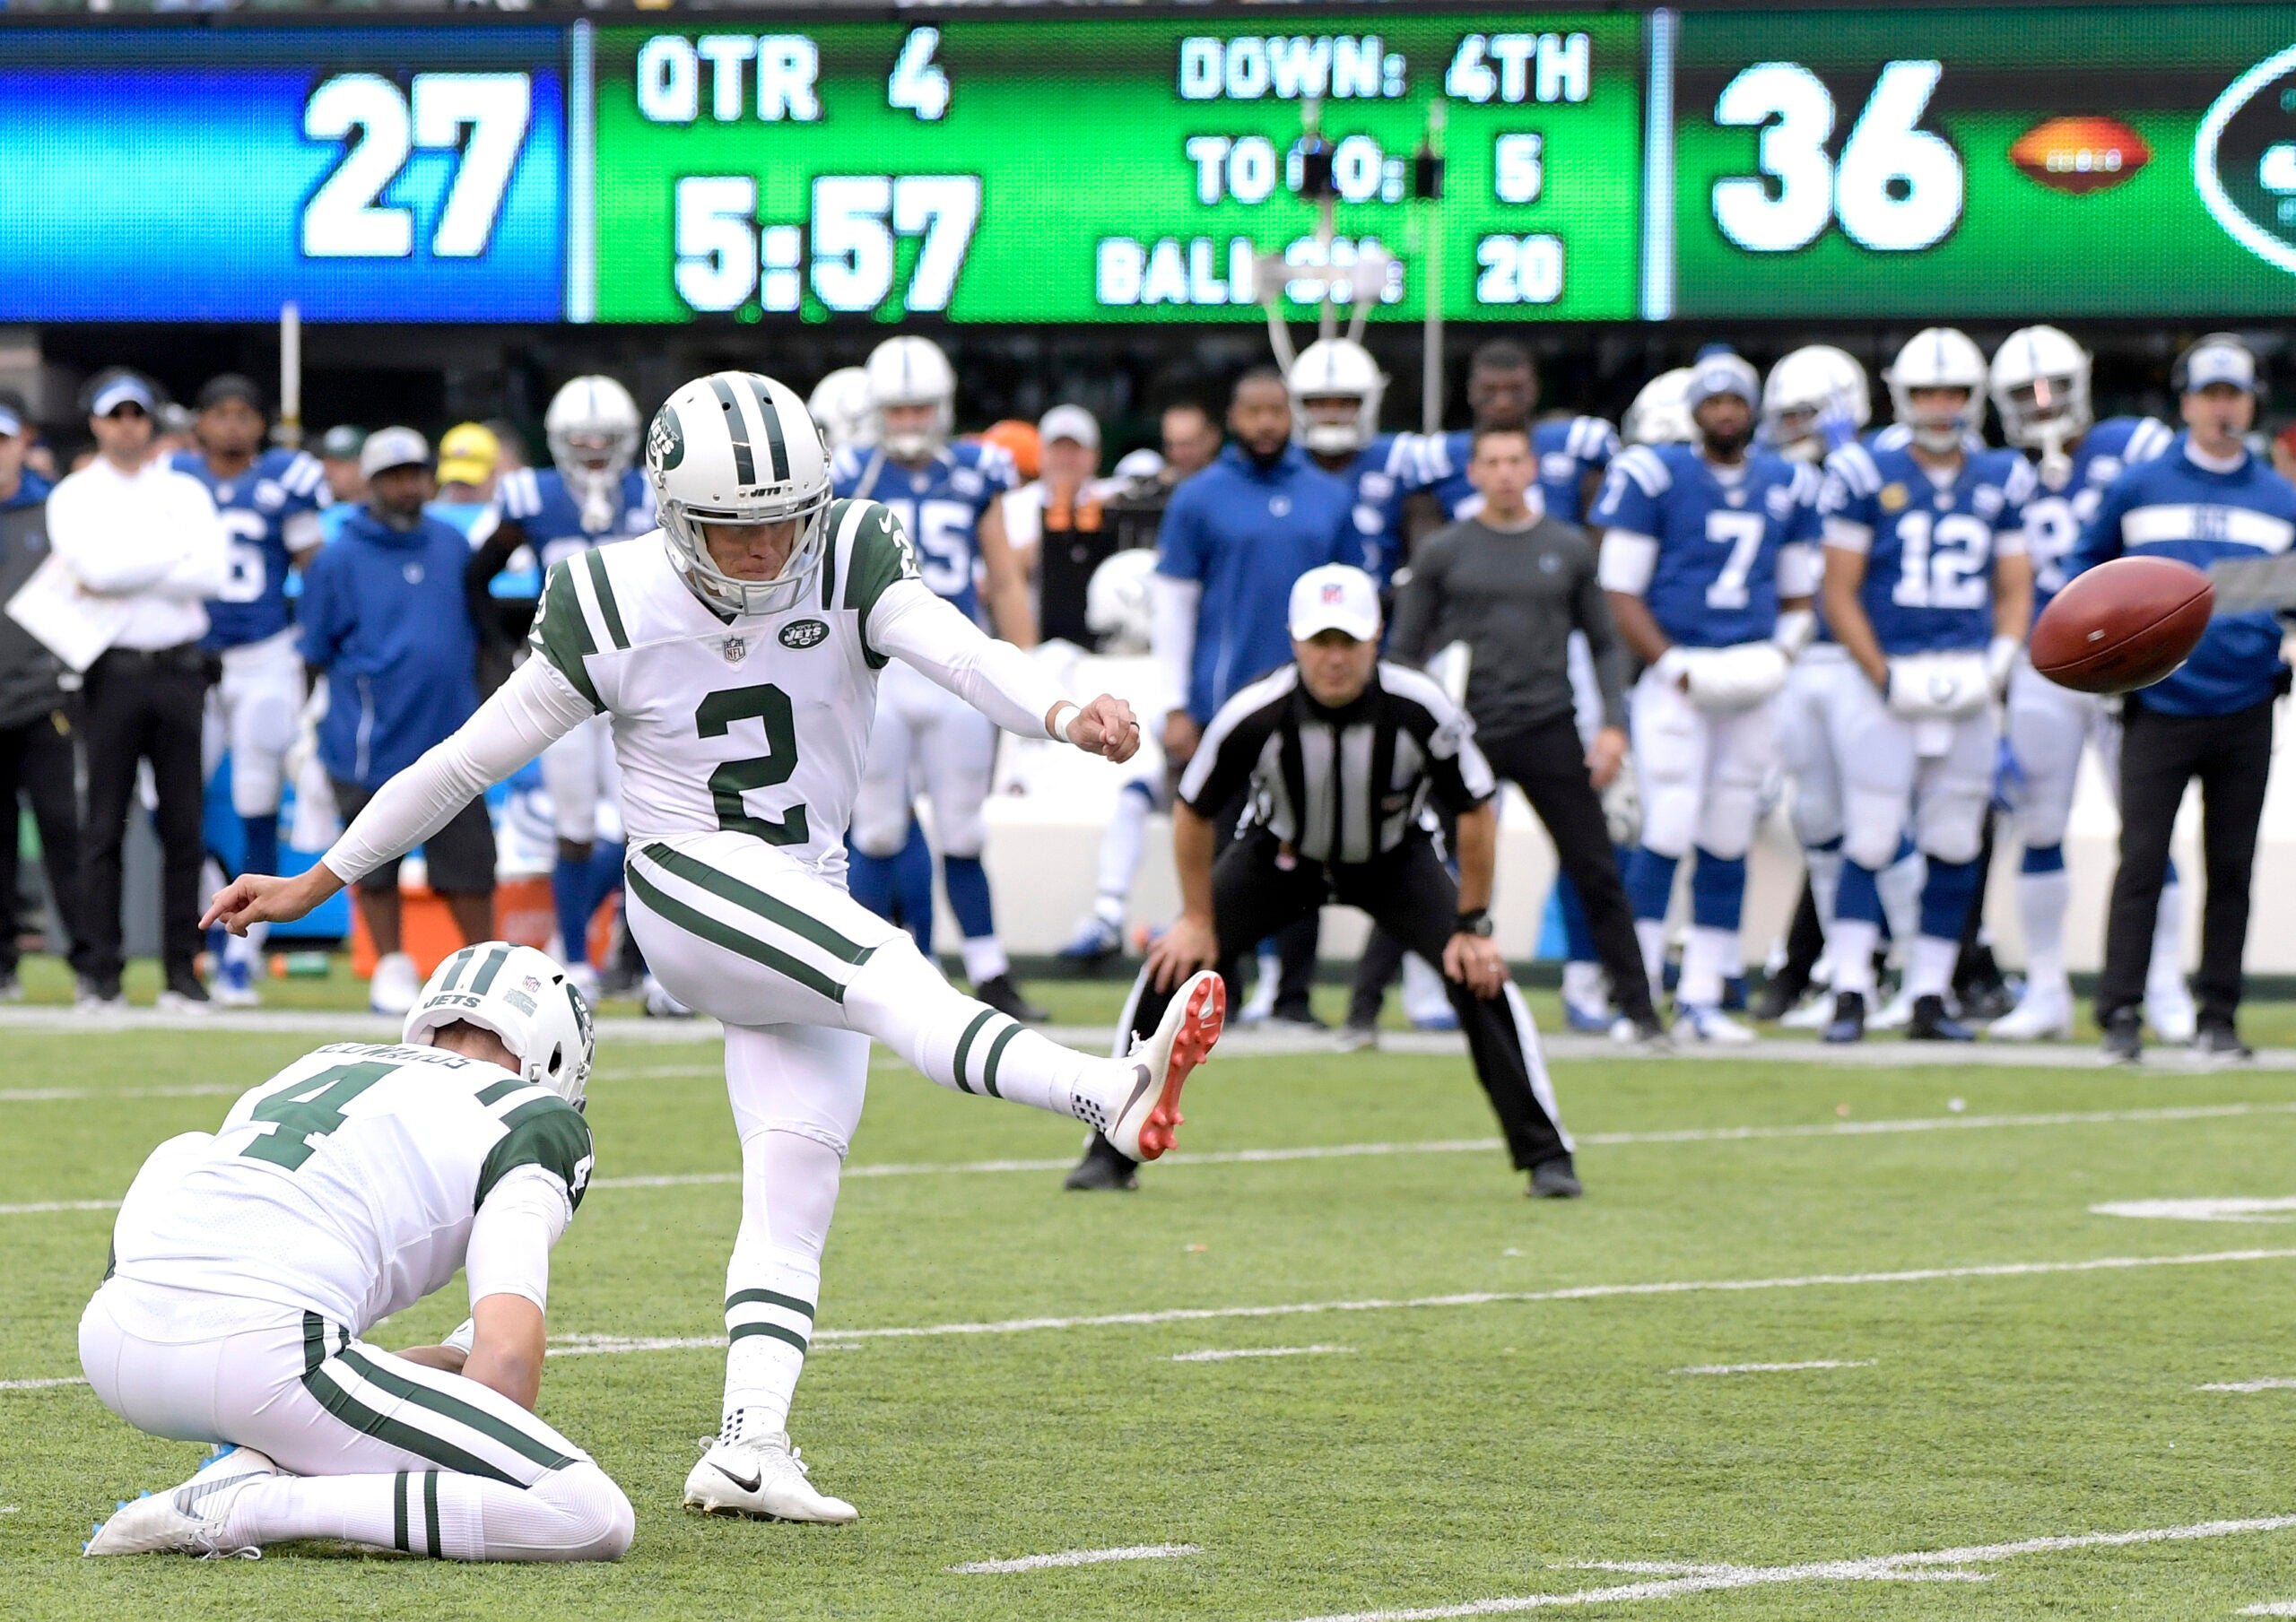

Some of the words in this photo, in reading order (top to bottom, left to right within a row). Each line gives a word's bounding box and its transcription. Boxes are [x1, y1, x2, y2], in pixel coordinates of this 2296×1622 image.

[638, 35, 819, 122] QTR
[889, 27, 950, 120] 4
[1180, 35, 1406, 100] DOWN:
[1445, 32, 1589, 102] 4TH
[303, 72, 530, 256] 27
[1187, 135, 1275, 204] TO
[1495, 134, 1542, 202] 5
[1713, 60, 1963, 251] 36
[674, 176, 981, 312] 5:57
[1477, 234, 1563, 303] 20
[750, 486, 781, 498] JETS
[1705, 510, 1766, 610] 7
[1892, 510, 1990, 610] 12
[726, 646, 744, 660] NFL
[784, 627, 822, 642] JETS
[695, 683, 810, 846] 2
[422, 994, 481, 1010] JETS
[239, 1061, 406, 1172] 4
